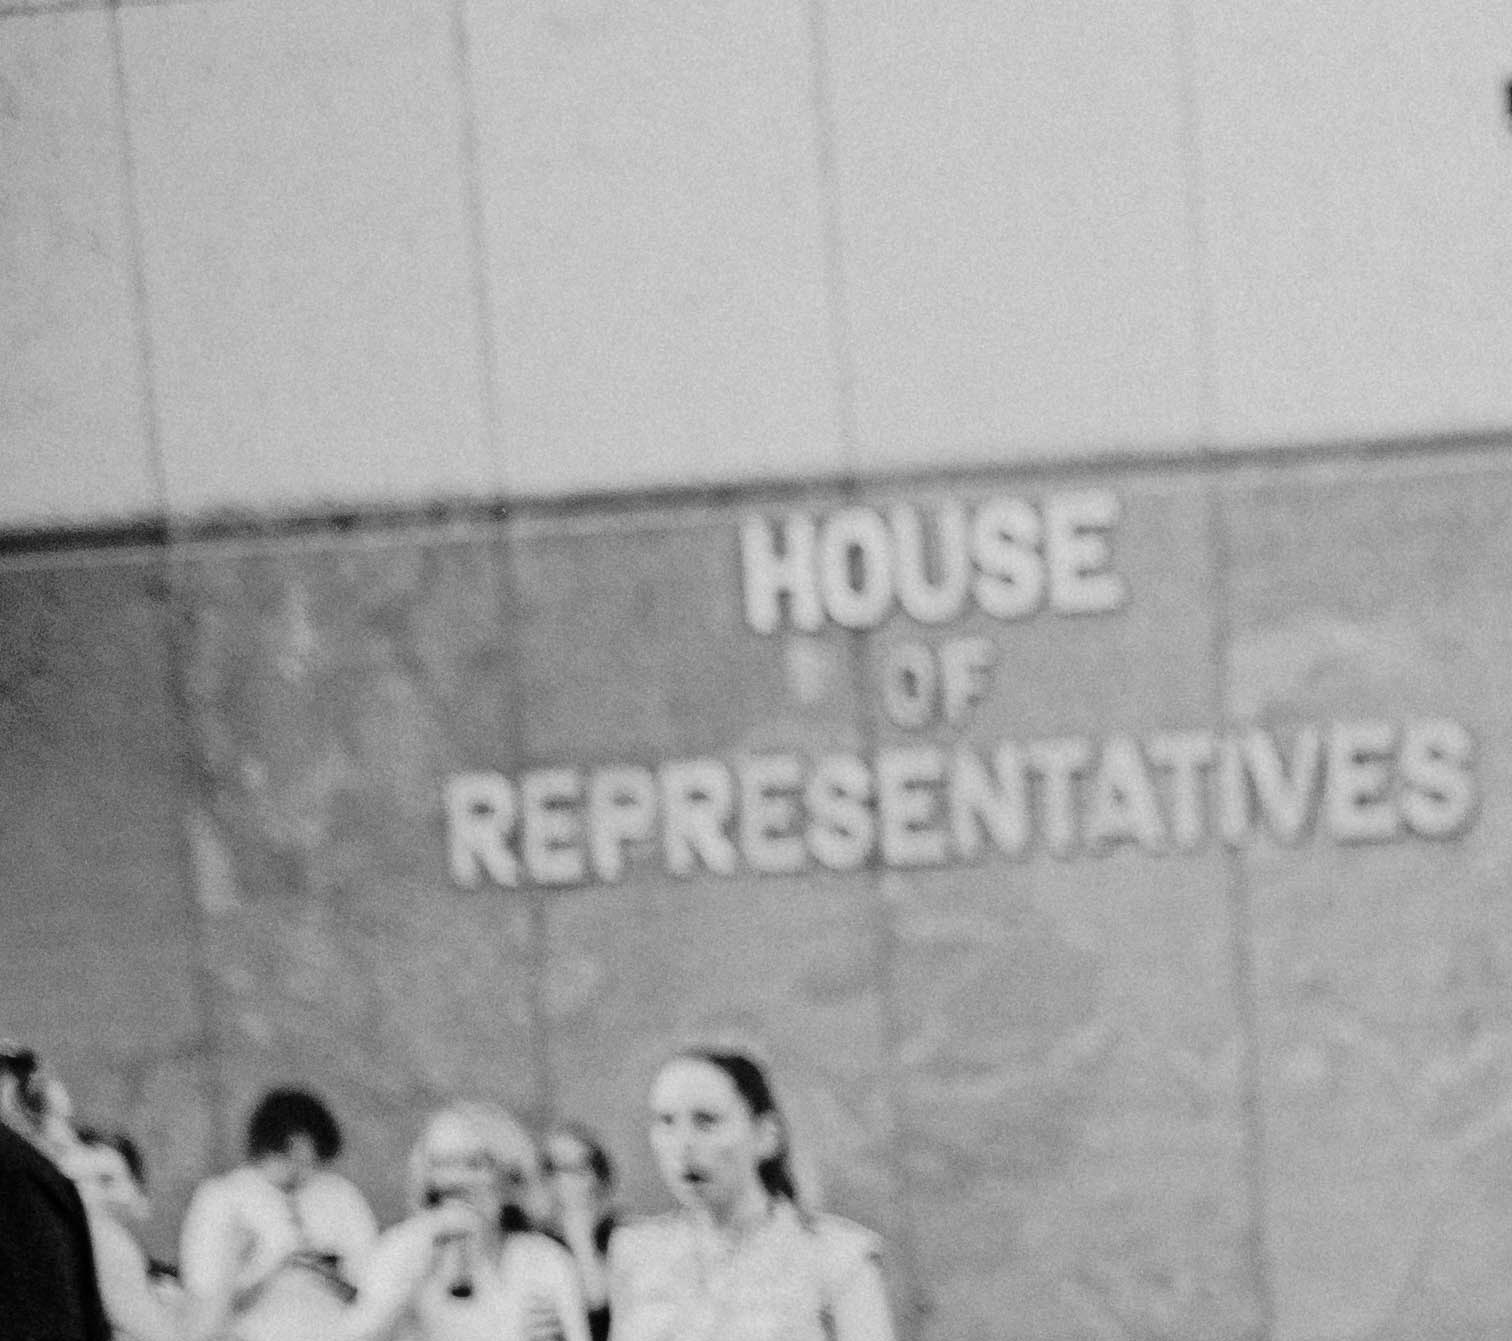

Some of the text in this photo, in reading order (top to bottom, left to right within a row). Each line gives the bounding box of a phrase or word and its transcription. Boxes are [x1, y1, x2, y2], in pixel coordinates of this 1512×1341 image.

[741, 490, 1127, 634] HOUSE
[881, 635, 996, 730] OF
[447, 715, 1481, 887] REPRESENTATIVES
